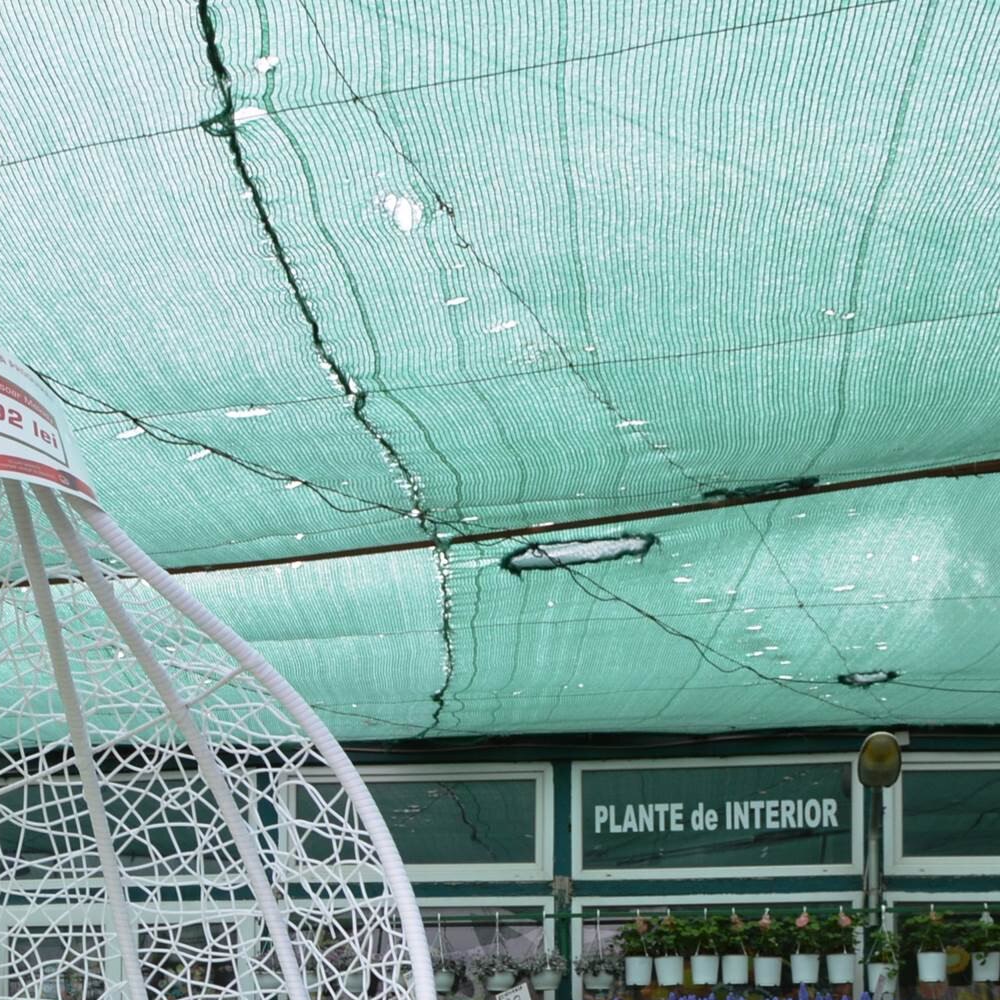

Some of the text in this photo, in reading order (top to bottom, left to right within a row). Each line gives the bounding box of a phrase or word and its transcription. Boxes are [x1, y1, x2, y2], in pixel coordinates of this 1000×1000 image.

[33, 420, 58, 449] lei
[594, 798, 839, 833] PLANTE de INTERIOR
